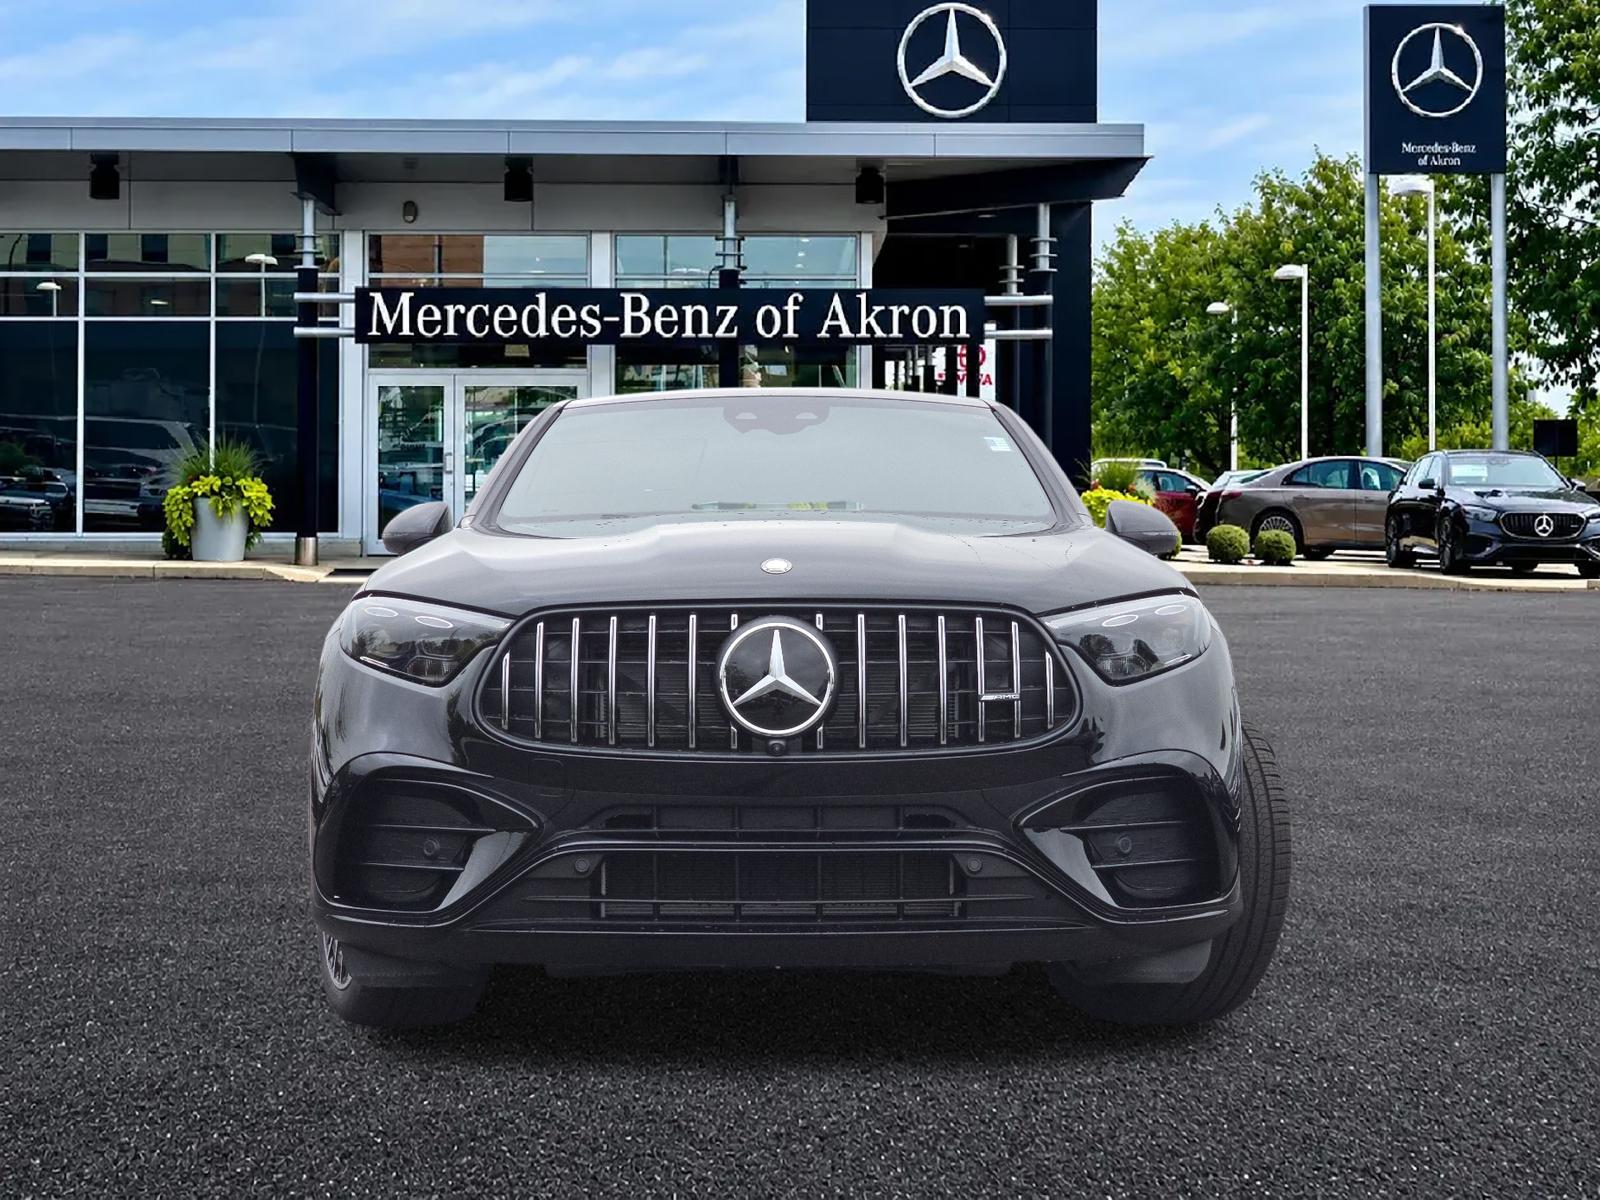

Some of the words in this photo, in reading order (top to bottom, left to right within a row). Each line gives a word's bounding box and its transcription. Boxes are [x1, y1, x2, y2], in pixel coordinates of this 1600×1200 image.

[1401, 141, 1477, 154] Mercedes-Benz
[1417, 154, 1430, 166] of
[1430, 154, 1461, 166] Akron
[367, 291, 739, 338] Mercedes-Benz
[755, 292, 804, 338] of
[816, 292, 971, 338] Akron
